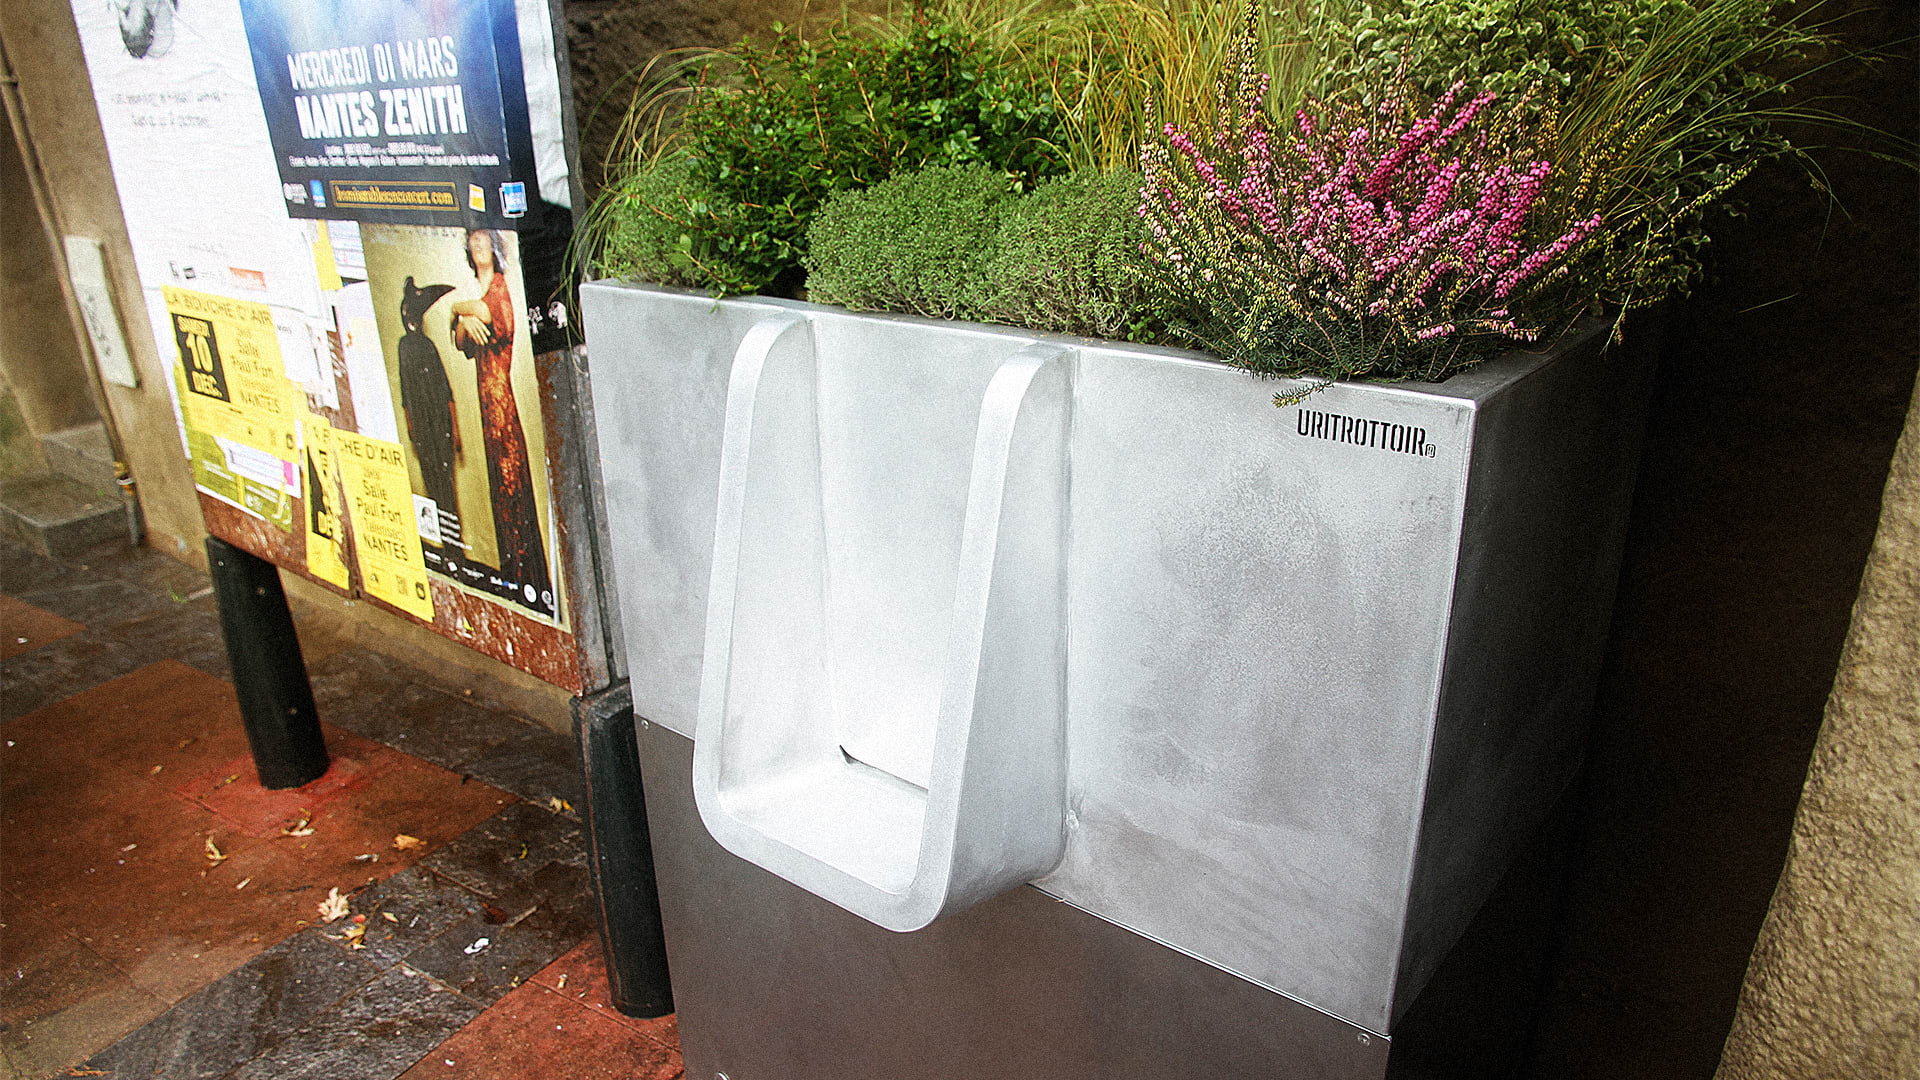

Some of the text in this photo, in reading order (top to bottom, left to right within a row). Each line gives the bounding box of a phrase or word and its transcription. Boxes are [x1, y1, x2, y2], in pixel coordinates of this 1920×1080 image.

[287, 45, 372, 90] MERCREDI
[397, 35, 459, 80] MARS
[295, 84, 468, 140] NANTES ZENITH
[185, 332, 214, 373] 10
[1297, 408, 1426, 456] URITROTTOIR
[366, 443, 404, 468] D'AIR
[362, 479, 388, 501] Salle
[356, 497, 403, 526] Paul Fort
[363, 533, 409, 562] NANTES
